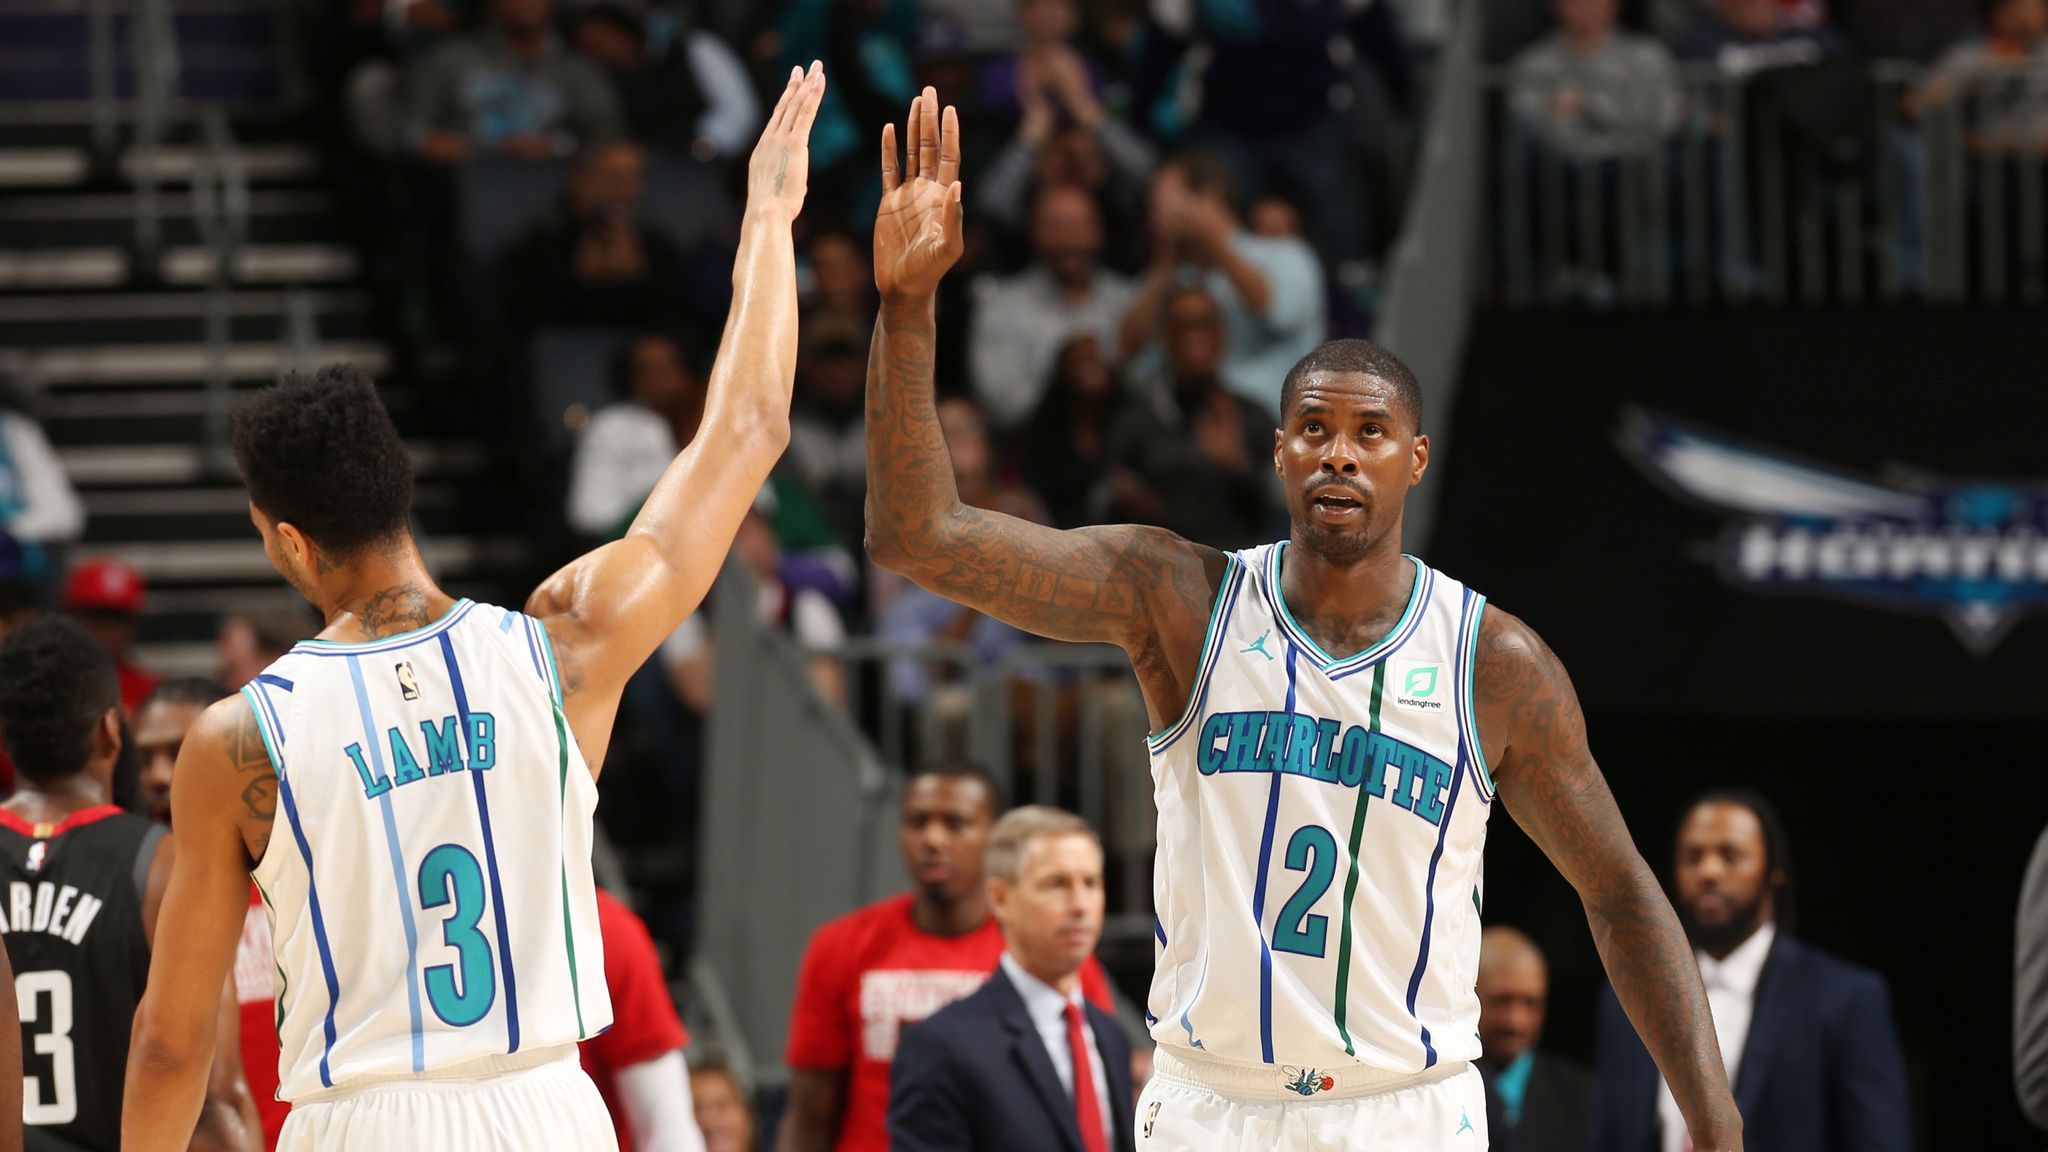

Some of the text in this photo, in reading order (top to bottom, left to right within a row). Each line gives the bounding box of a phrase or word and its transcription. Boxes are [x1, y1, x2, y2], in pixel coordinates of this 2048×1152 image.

[344, 712, 496, 799] LAMB
[1397, 697, 1441, 709] lendingtree
[1198, 710, 1453, 827] CHARLOTTE
[418, 843, 497, 1028] 3
[1271, 824, 1338, 959] 2
[15, 970, 77, 1125] 3
